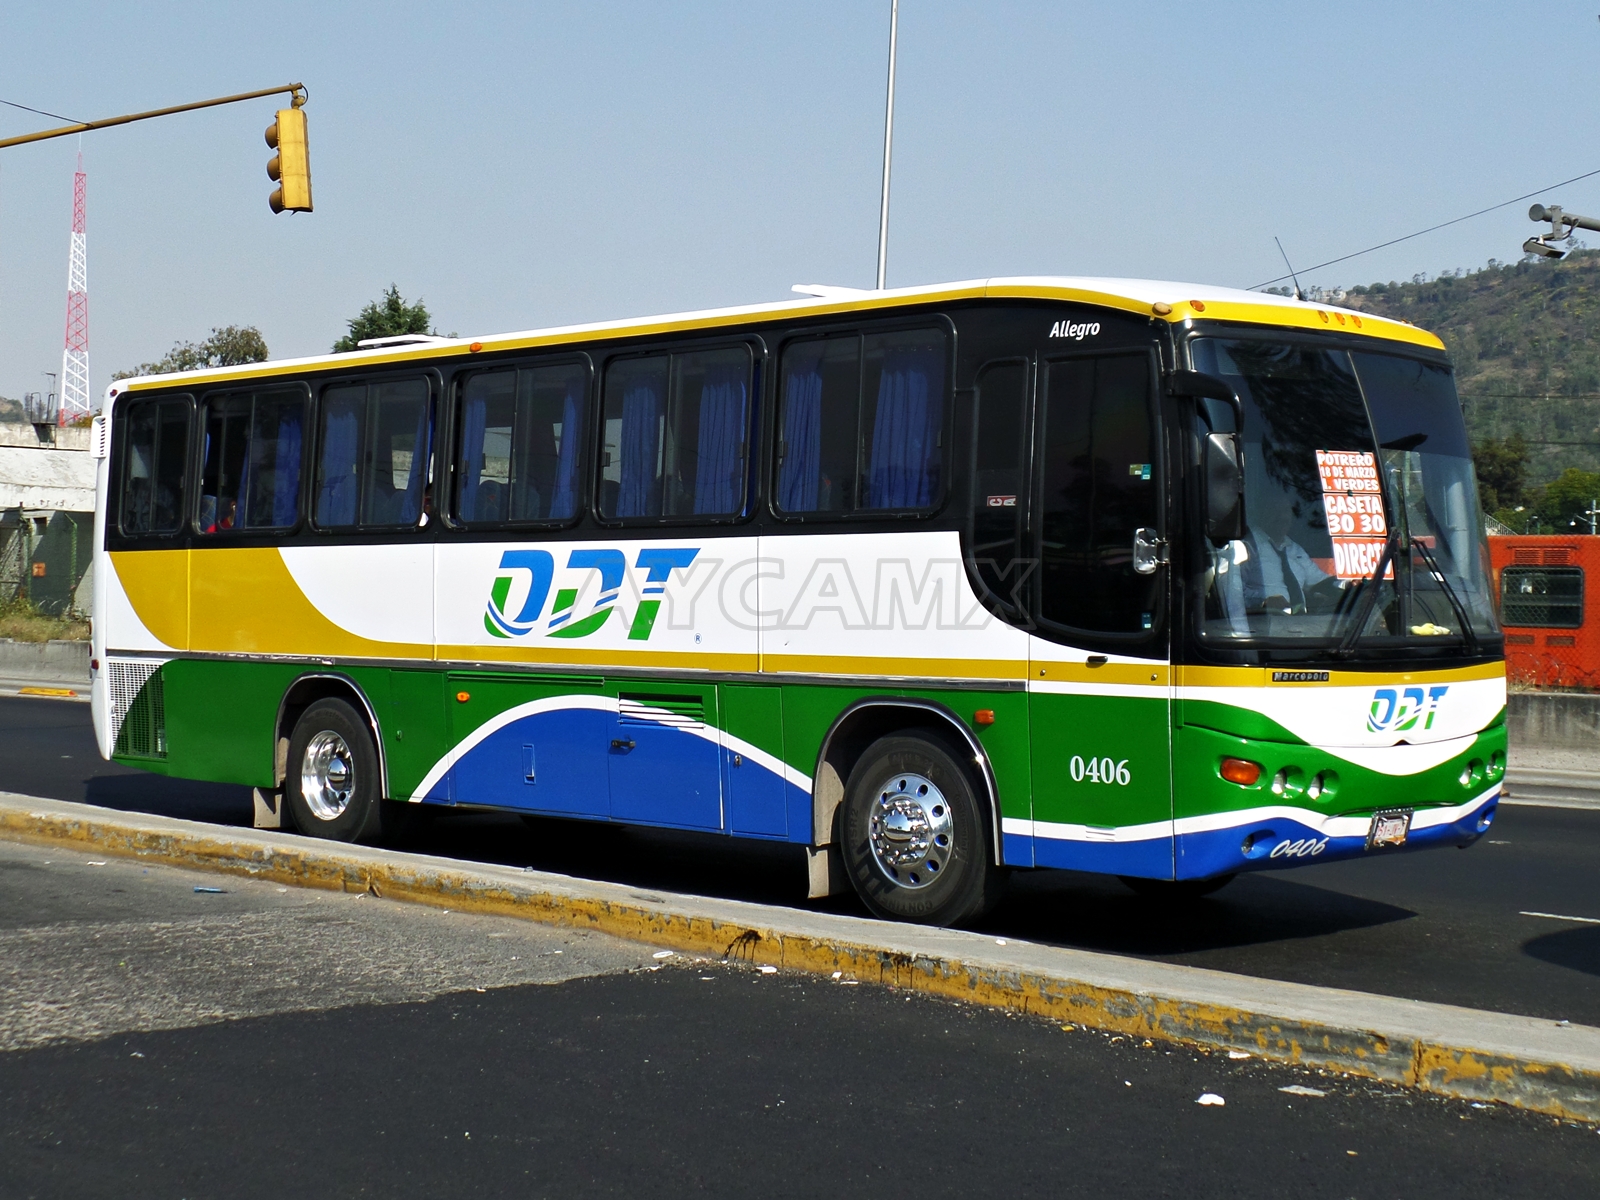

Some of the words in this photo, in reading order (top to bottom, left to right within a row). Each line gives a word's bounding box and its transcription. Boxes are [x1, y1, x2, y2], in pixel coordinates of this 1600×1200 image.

[1049, 320, 1101, 341] Allegro
[1318, 453, 1373, 467] POTRERO
[1320, 466, 1332, 478] 18
[1333, 466, 1345, 478] DE
[1345, 467, 1376, 479] MARZO
[1333, 478, 1379, 491] VERDES
[1326, 496, 1382, 514] CASETA
[1329, 514, 1355, 533] 30
[1360, 514, 1385, 533] 30
[1274, 672, 1329, 681] Marcopolo
[1070, 755, 1131, 786] 0406
[1269, 836, 1330, 858] 0406
